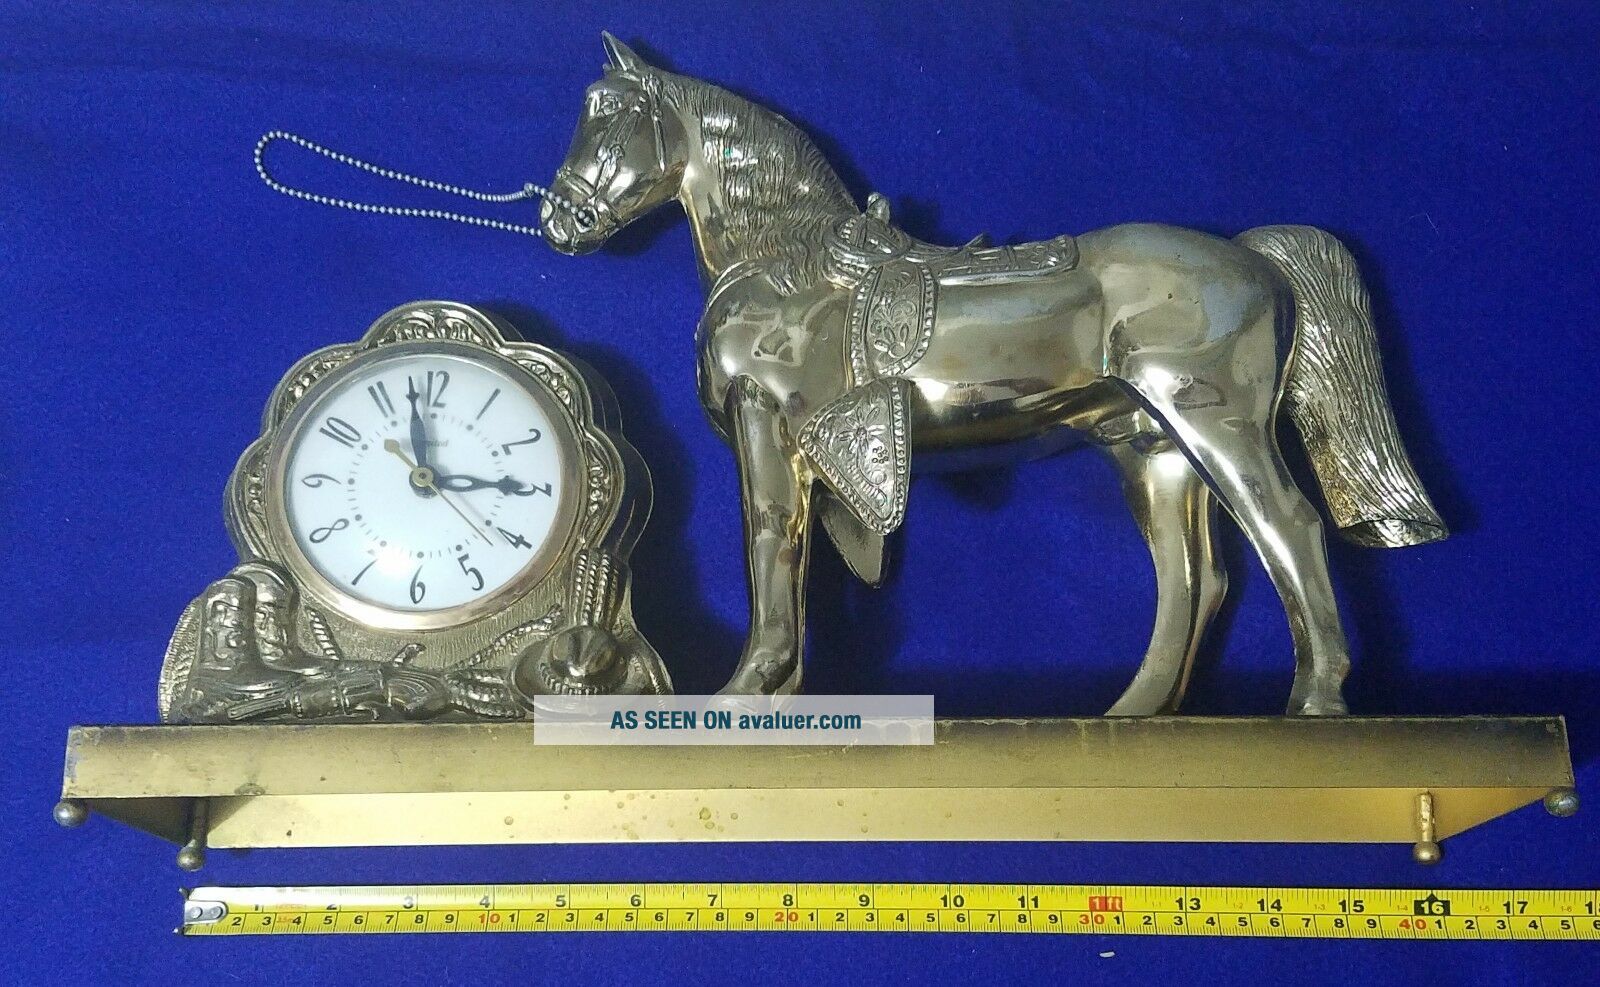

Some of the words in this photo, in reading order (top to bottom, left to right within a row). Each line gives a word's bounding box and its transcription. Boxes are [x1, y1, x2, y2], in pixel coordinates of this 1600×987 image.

[367, 381, 396, 418] 11
[427, 371, 450, 408] 12
[476, 388, 501, 420] 1
[319, 416, 362, 449] 10
[501, 428, 542, 456] 2
[301, 473, 342, 489] 9
[511, 481, 552, 498] 3
[309, 518, 350, 544] 8
[496, 527, 533, 550] 4
[410, 564, 426, 604] 6
[457, 553, 485, 591] 5
[403, 896, 414, 909] 3
[479, 895, 490, 908] 4
[555, 894, 566, 907] 5
[630, 894, 642, 907] 6
[707, 894, 718, 907] 7
[782, 894, 794, 907] 8
[858, 894, 870, 907] 9
[940, 895, 965, 908] 10
[1017, 895, 1039, 908] 11
[1175, 897, 1201, 911] 13
[1257, 898, 1282, 912] 14
[1338, 899, 1364, 913] 15
[1421, 902, 1444, 914] 16
[1503, 901, 1529, 914] 17
[232, 916, 242, 926] 2
[262, 916, 272, 925] 3
[293, 916, 302, 925] 4
[323, 915, 333, 925] 5
[354, 915, 364, 925] 6
[385, 914, 395, 924] 7
[414, 914, 424, 924] 8
[444, 913, 454, 923] 9
[478, 913, 500, 924] 10
[508, 913, 516, 923] 1
[535, 912, 545, 923] 2
[565, 912, 575, 922] 3
[594, 912, 604, 922] 4
[624, 912, 634, 922] 5
[654, 912, 664, 922] 6
[685, 912, 694, 922] 7
[715, 912, 725, 922] 8
[744, 912, 754, 922] 9
[774, 911, 799, 922] 20
[807, 912, 815, 922] 1
[835, 912, 845, 922] 2
[865, 912, 875, 922] 3
[895, 913, 905, 923] 4
[926, 913, 936, 923] 5
[956, 913, 966, 923] 6
[986, 913, 996, 923] 7
[1017, 913, 1027, 924] 8
[1048, 914, 1058, 924] 9
[1078, 914, 1105, 925] 30
[1113, 915, 1121, 925] 1
[1142, 915, 1153, 925] 2
[1173, 916, 1184, 926] 3
[1205, 916, 1216, 926] 4
[1238, 916, 1248, 927] 5
[1269, 917, 1280, 928] 6
[1301, 918, 1311, 928] 7
[1333, 918, 1344, 928] 8
[1366, 918, 1377, 929] 9
[1399, 918, 1427, 929] 40
[1434, 919, 1442, 929] 1
[1464, 919, 1475, 929] 2
[1496, 919, 1506, 930] 3
[1528, 919, 1538, 930] 4
[1560, 919, 1571, 930] 5
